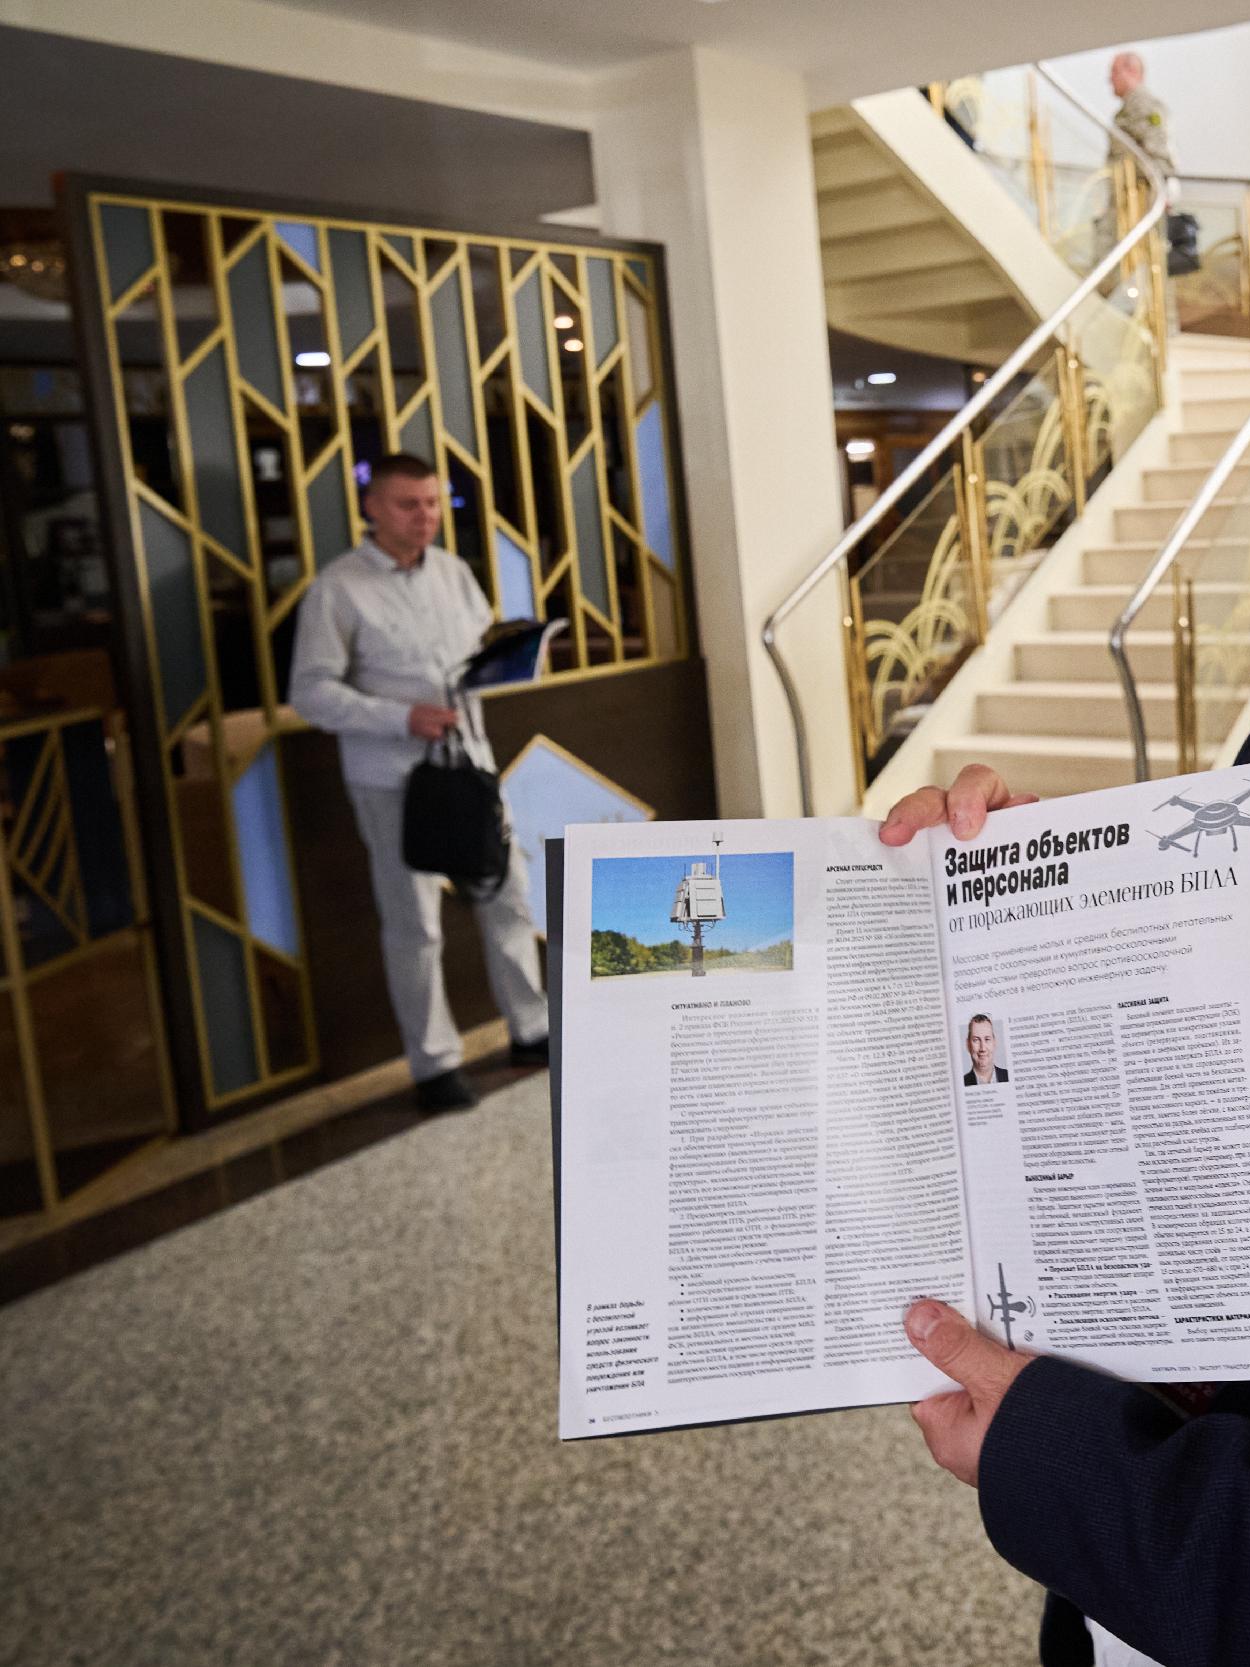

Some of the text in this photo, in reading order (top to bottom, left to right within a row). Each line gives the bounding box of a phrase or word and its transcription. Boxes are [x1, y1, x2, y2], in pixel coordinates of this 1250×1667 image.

[945, 823, 1130, 877] Защита объектов
[947, 862, 1069, 906] и персонала
[949, 867, 1239, 933] от поражающих элементов БПЛА
[952, 913, 1233, 965] Массовое применение малых и средних беспилотных летательных
[953, 935, 1177, 979] аппаратов с осколочными и кумулятивно-осколочными
[954, 944, 1193, 991] боевыми частями превратило вопрос противоосколочной
[956, 992, 983, 1005] защиты
[984, 985, 1019, 999] объектов
[1026, 978, 1077, 994] неотложную
[1078, 969, 1133, 986] инженерную
[1134, 964, 1168, 978] задачу.
